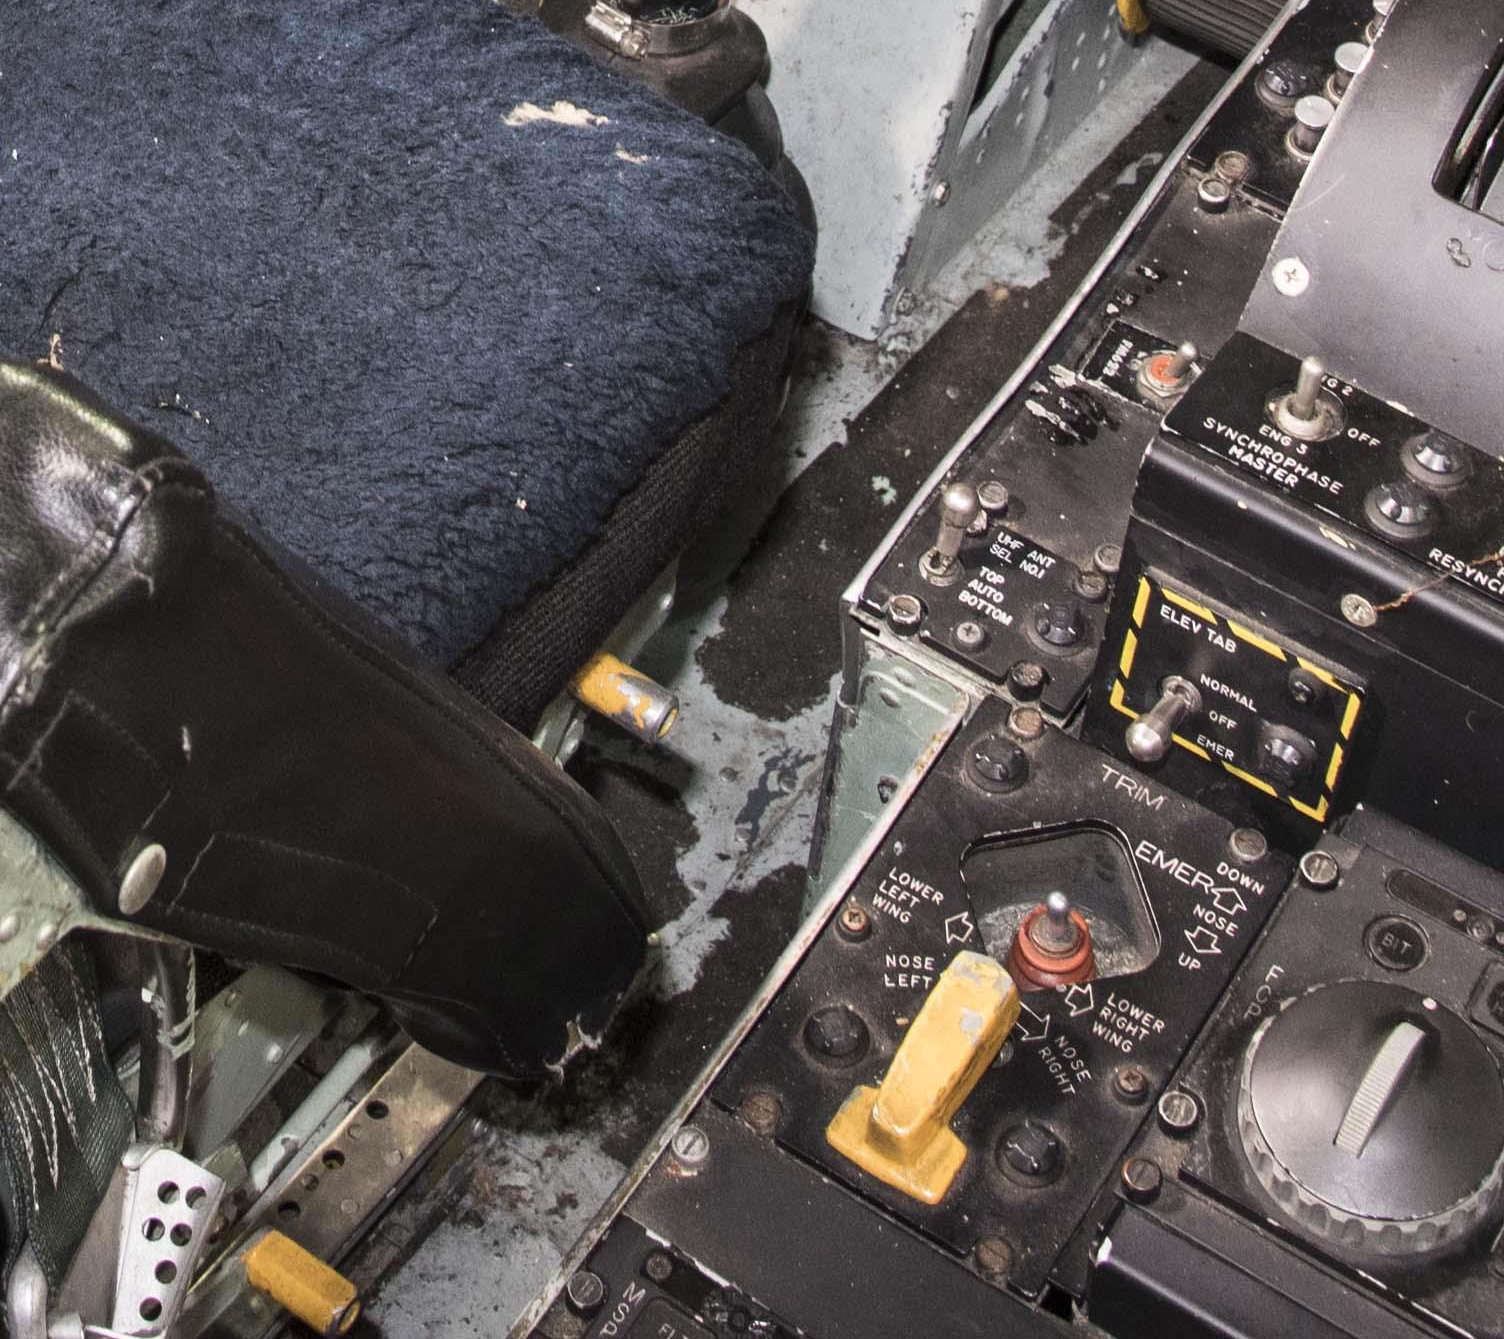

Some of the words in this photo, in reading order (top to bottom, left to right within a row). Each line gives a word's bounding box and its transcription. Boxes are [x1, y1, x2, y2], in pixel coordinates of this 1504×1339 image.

[1347, 427, 1381, 447] OFF
[1203, 416, 1344, 495] SYNCHROPHASE
[1228, 446, 1299, 488] MASTER
[997, 532, 1024, 551] UHF
[1028, 549, 1056, 568] ANT
[967, 576, 1004, 604] AUTO
[980, 567, 1006, 587] TOP
[958, 591, 1014, 626] BOTTOM
[1159, 604, 1209, 635] ELEV
[1204, 629, 1238, 654] TAB
[1200, 673, 1259, 712] NORMAL
[1208, 711, 1238, 731] OFF
[1196, 734, 1236, 761] EMER
[1100, 765, 1168, 812] TRIM
[1134, 840, 1215, 892] EMER
[1216, 861, 1266, 895] DOWN
[878, 881, 922, 908] LEFT
[889, 866, 944, 905] LOWER
[872, 893, 912, 923] WING
[1192, 903, 1240, 939] NOSE
[1381, 931, 1411, 953] BIT
[884, 955, 934, 971] NOSE
[1178, 951, 1203, 971] UP
[884, 973, 933, 989] LEFT
[1098, 1006, 1150, 1042] RIGHT
[1107, 992, 1166, 1033] LOWER
[1092, 1021, 1134, 1053] WING
[1038, 1045, 1076, 1097] RIGHT
[1053, 1036, 1092, 1083] NOSE
